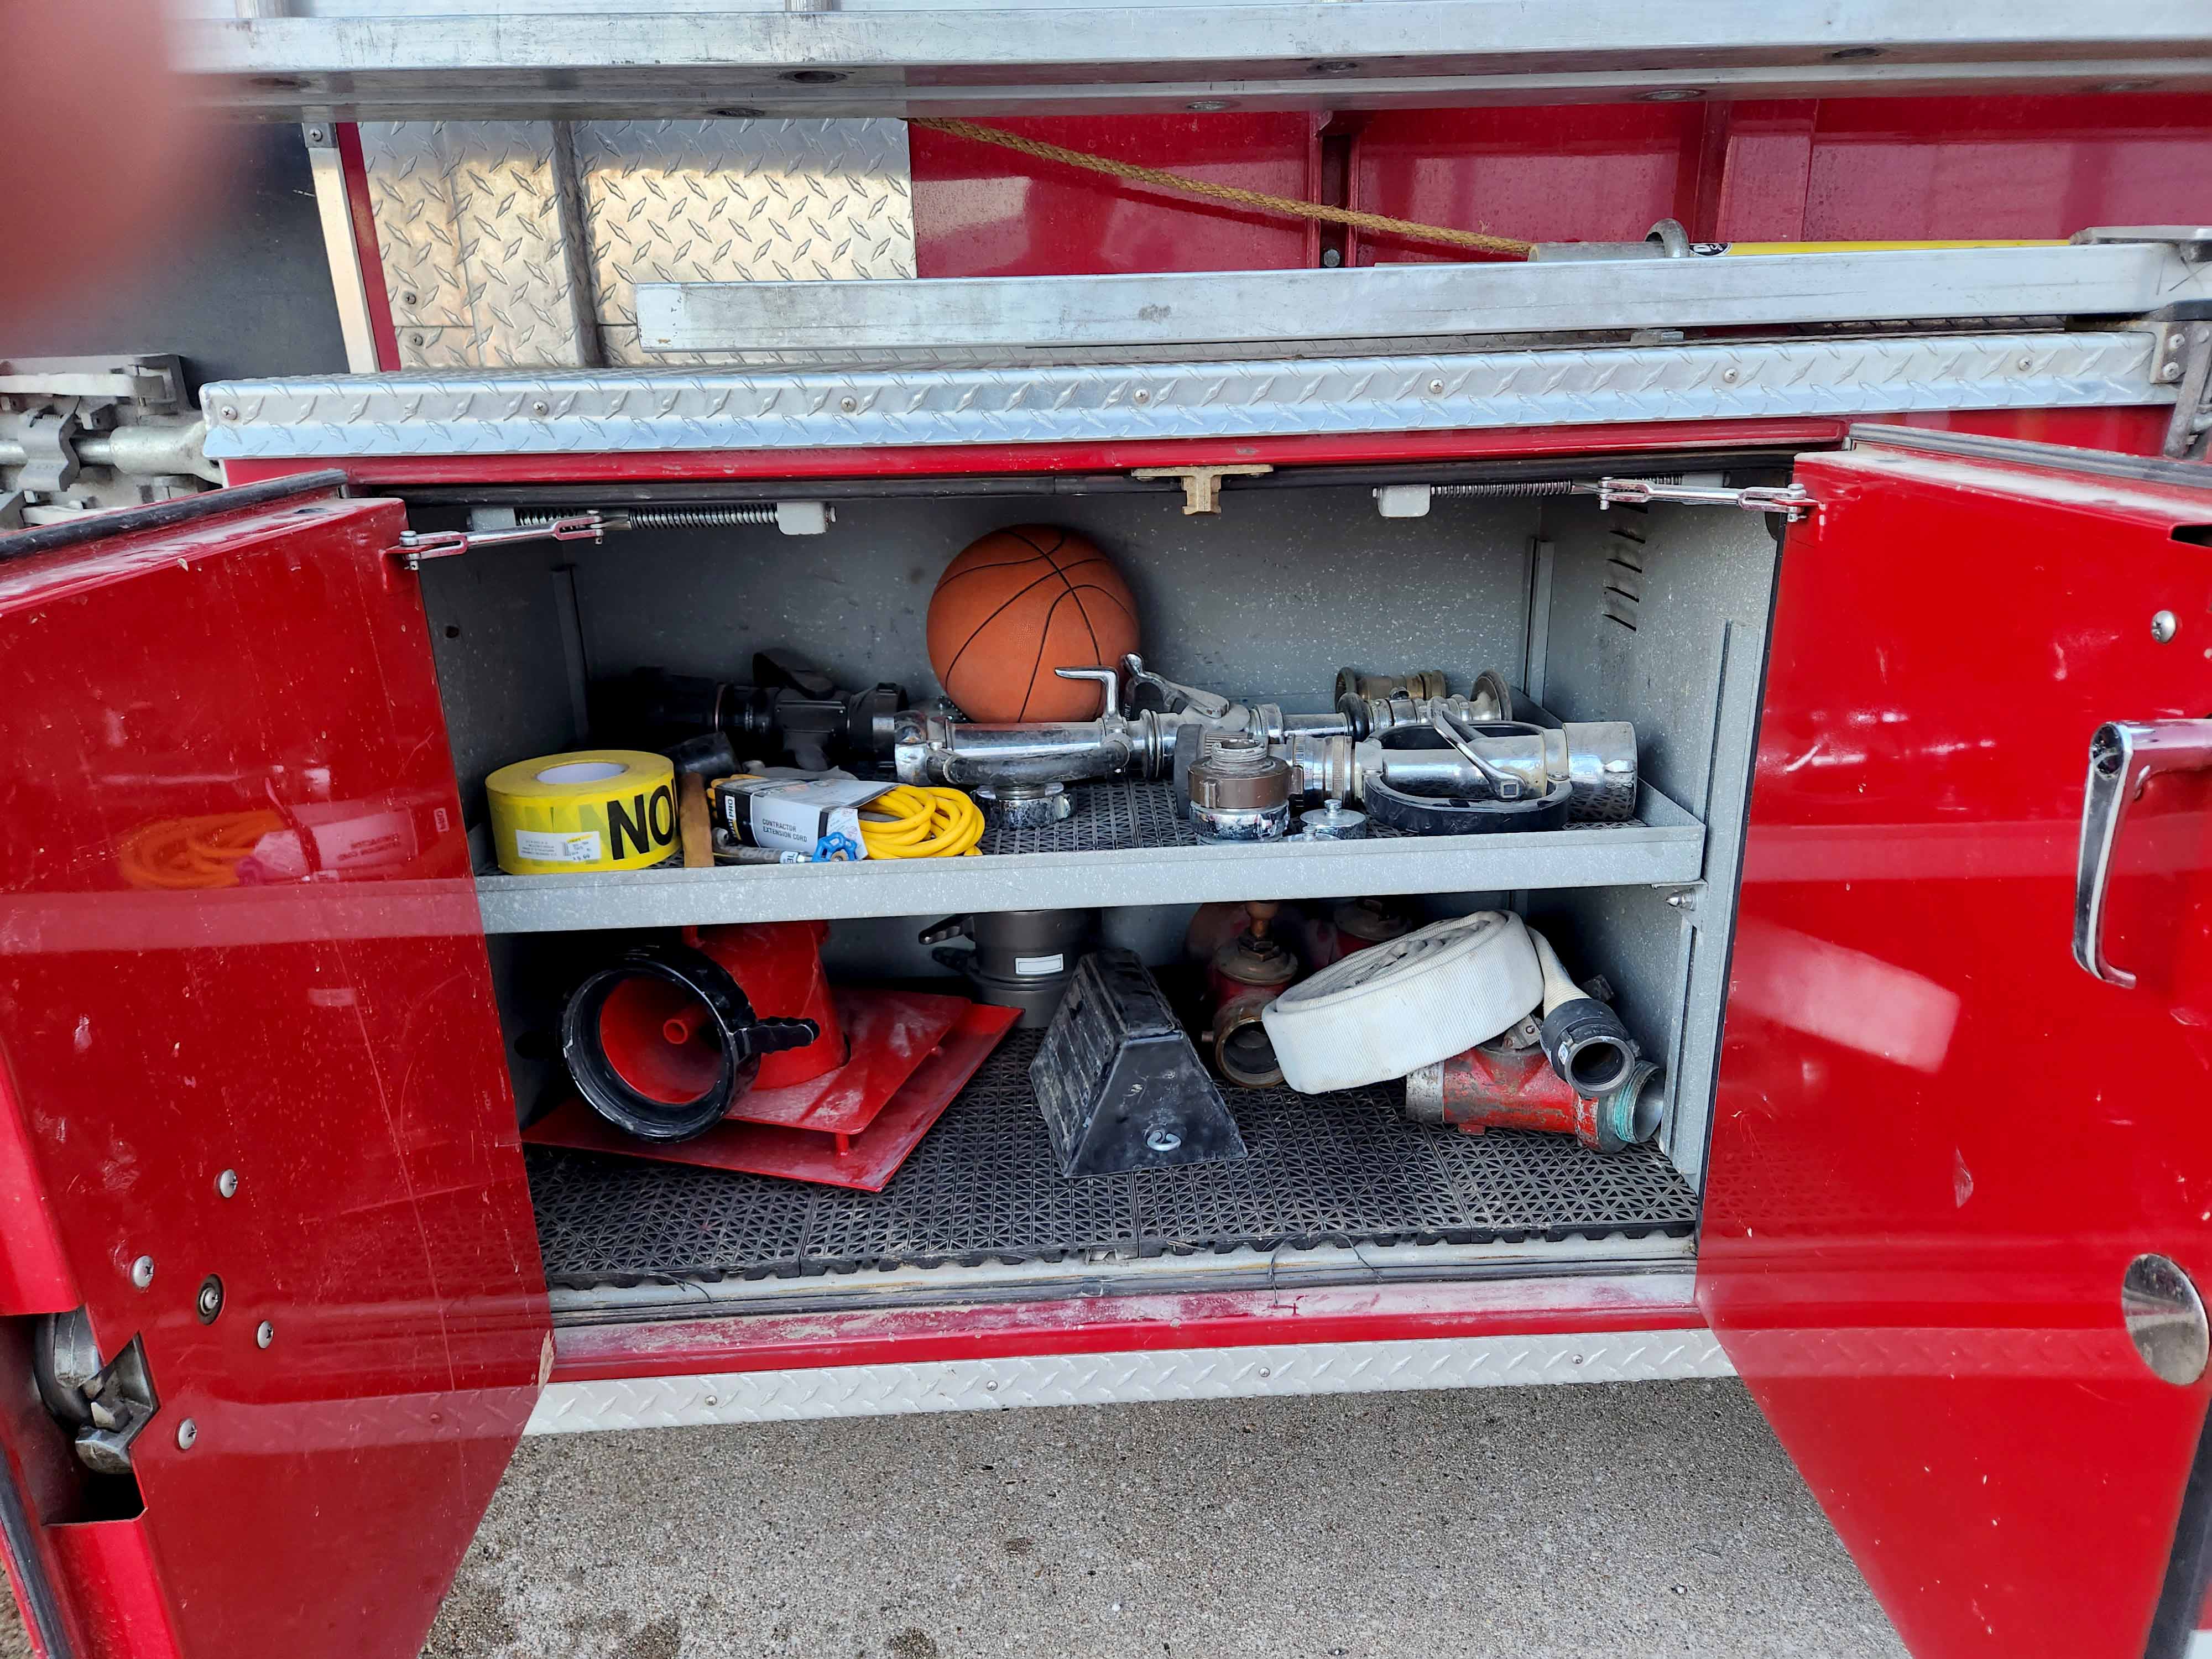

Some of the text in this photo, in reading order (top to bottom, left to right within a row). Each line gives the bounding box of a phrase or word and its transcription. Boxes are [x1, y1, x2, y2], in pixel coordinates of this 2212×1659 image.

[607, 779, 678, 860] NO
[762, 818, 796, 832] CONTRACTOR
[763, 826, 807, 842] EXTENSION CORD
